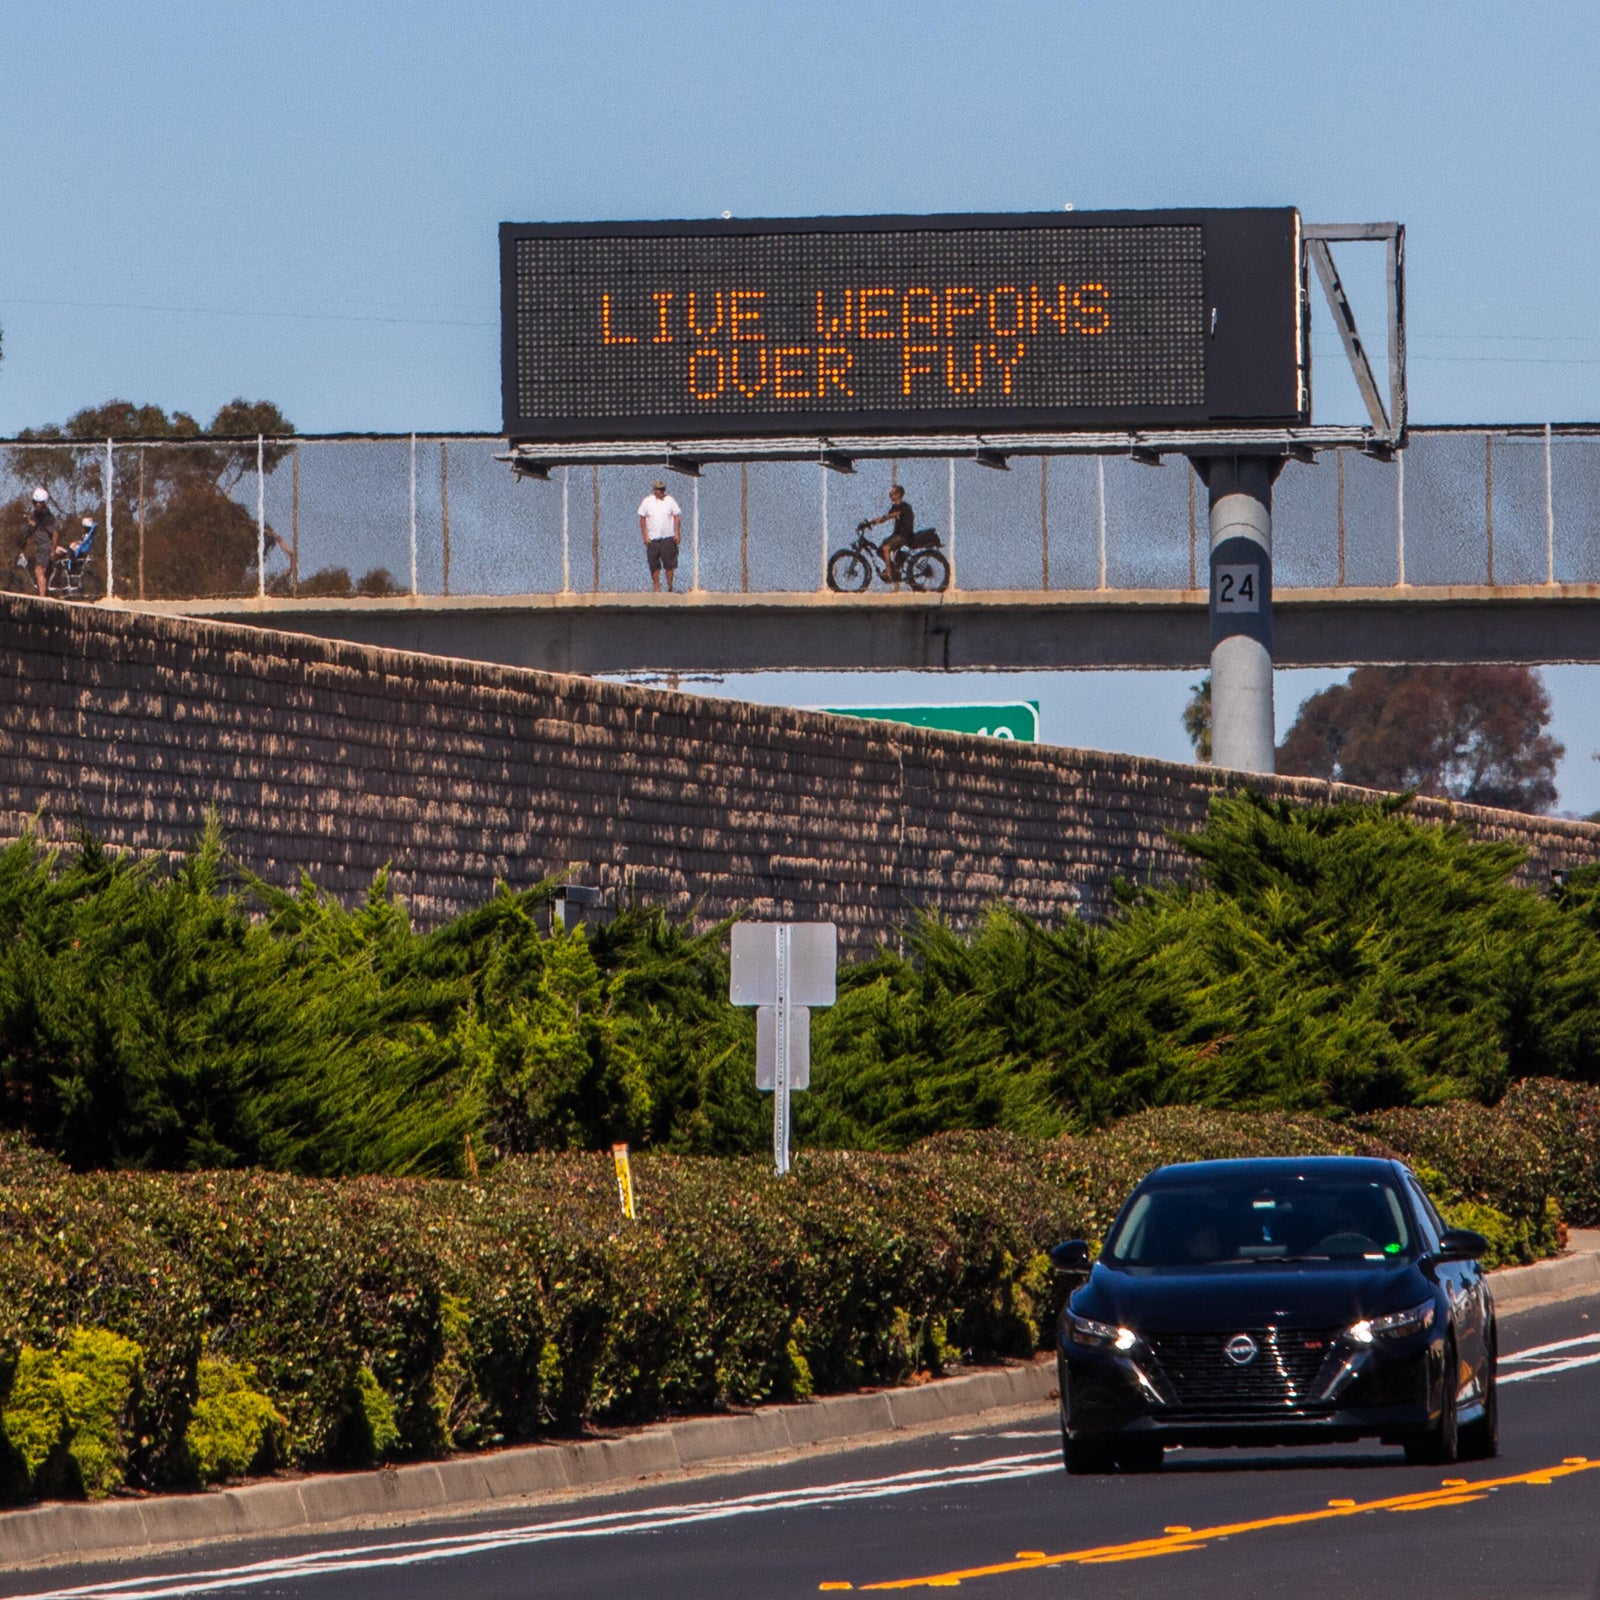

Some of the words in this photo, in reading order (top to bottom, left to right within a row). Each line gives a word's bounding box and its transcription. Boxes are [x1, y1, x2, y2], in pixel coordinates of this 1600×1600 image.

[603, 289, 766, 343] LIVE
[816, 283, 1110, 340] WEAPONS
[688, 346, 854, 400] OVER
[903, 343, 1025, 395] FWY
[1220, 573, 1254, 603] 24
